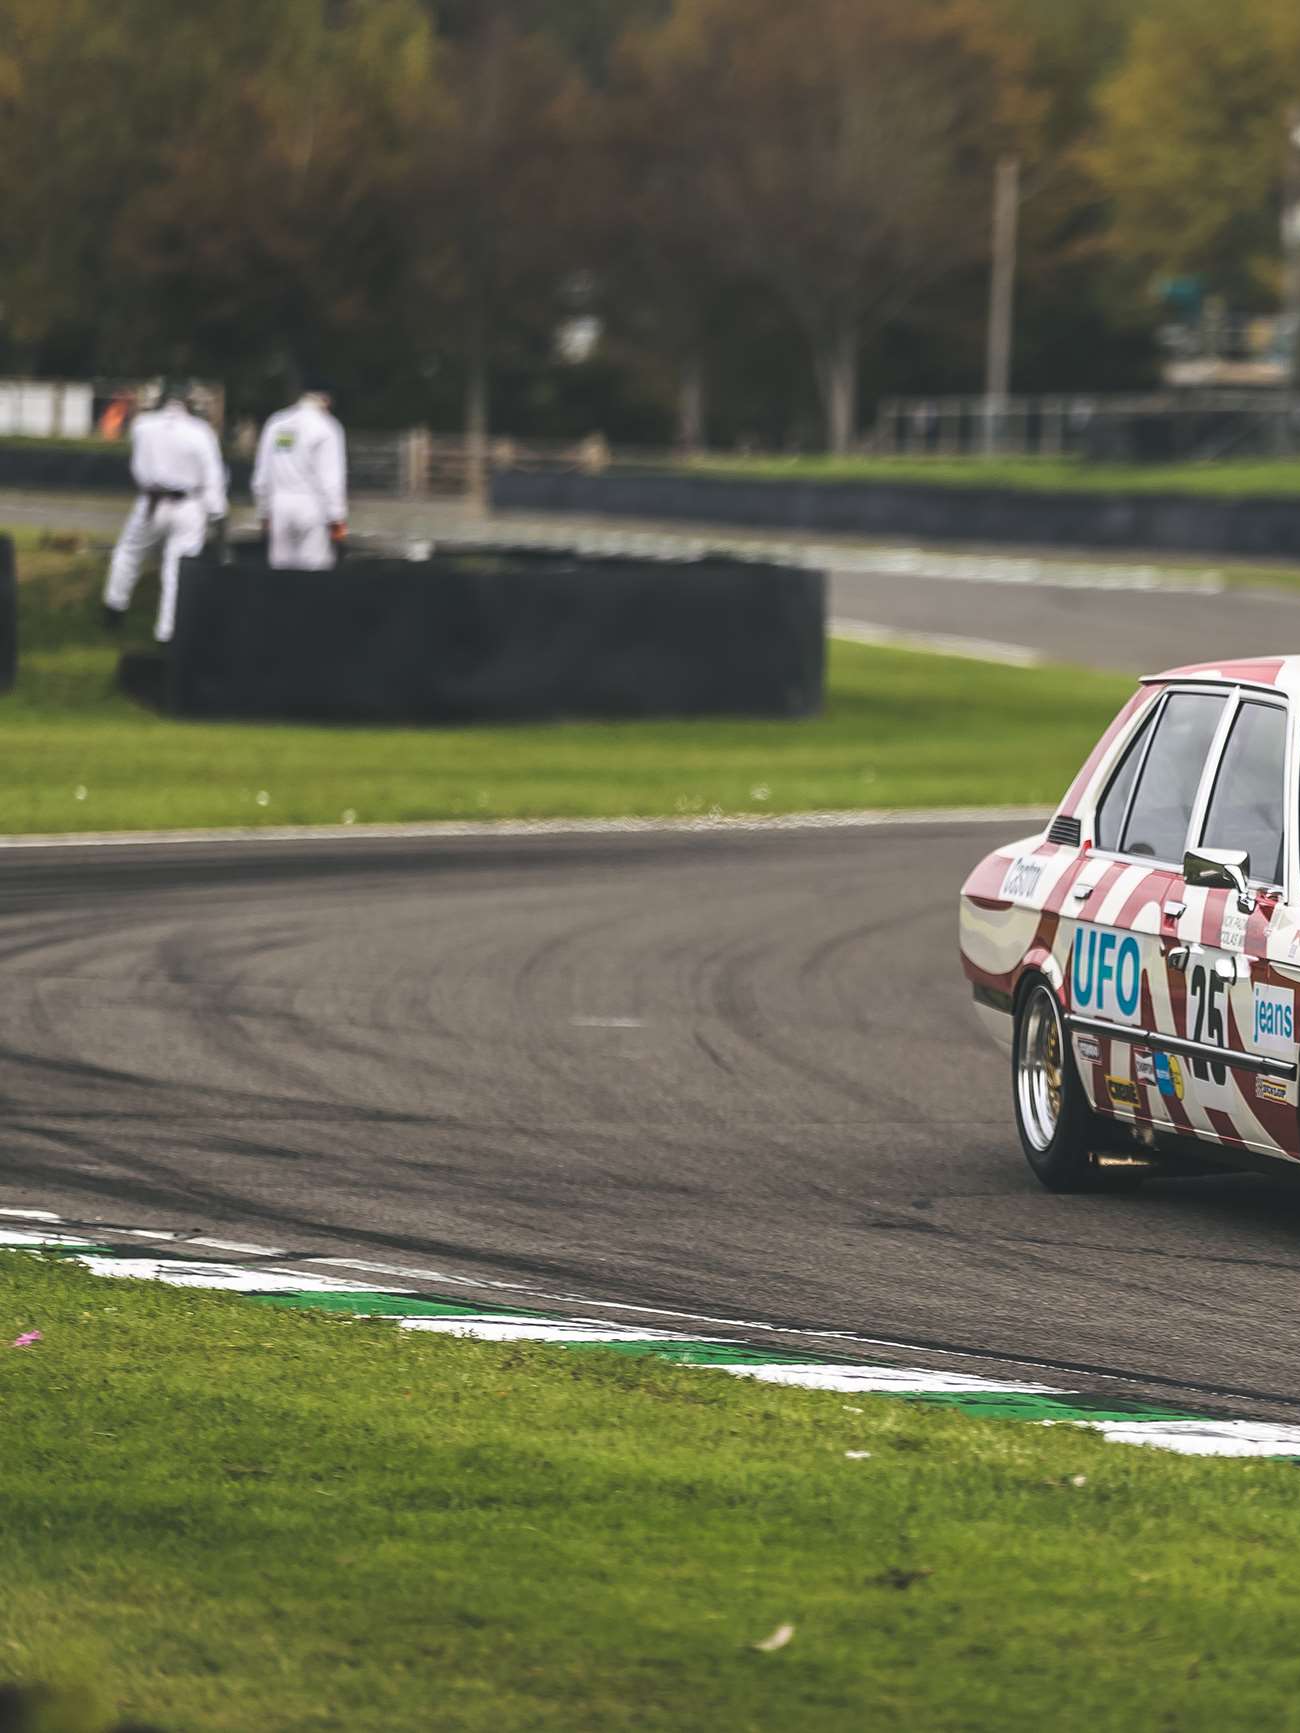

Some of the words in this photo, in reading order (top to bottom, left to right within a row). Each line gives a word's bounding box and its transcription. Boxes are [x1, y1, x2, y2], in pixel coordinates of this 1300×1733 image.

[1072, 927, 1141, 1017] UFO
[1254, 987, 1293, 1043] jeans
[1191, 964, 1227, 1086] 25
